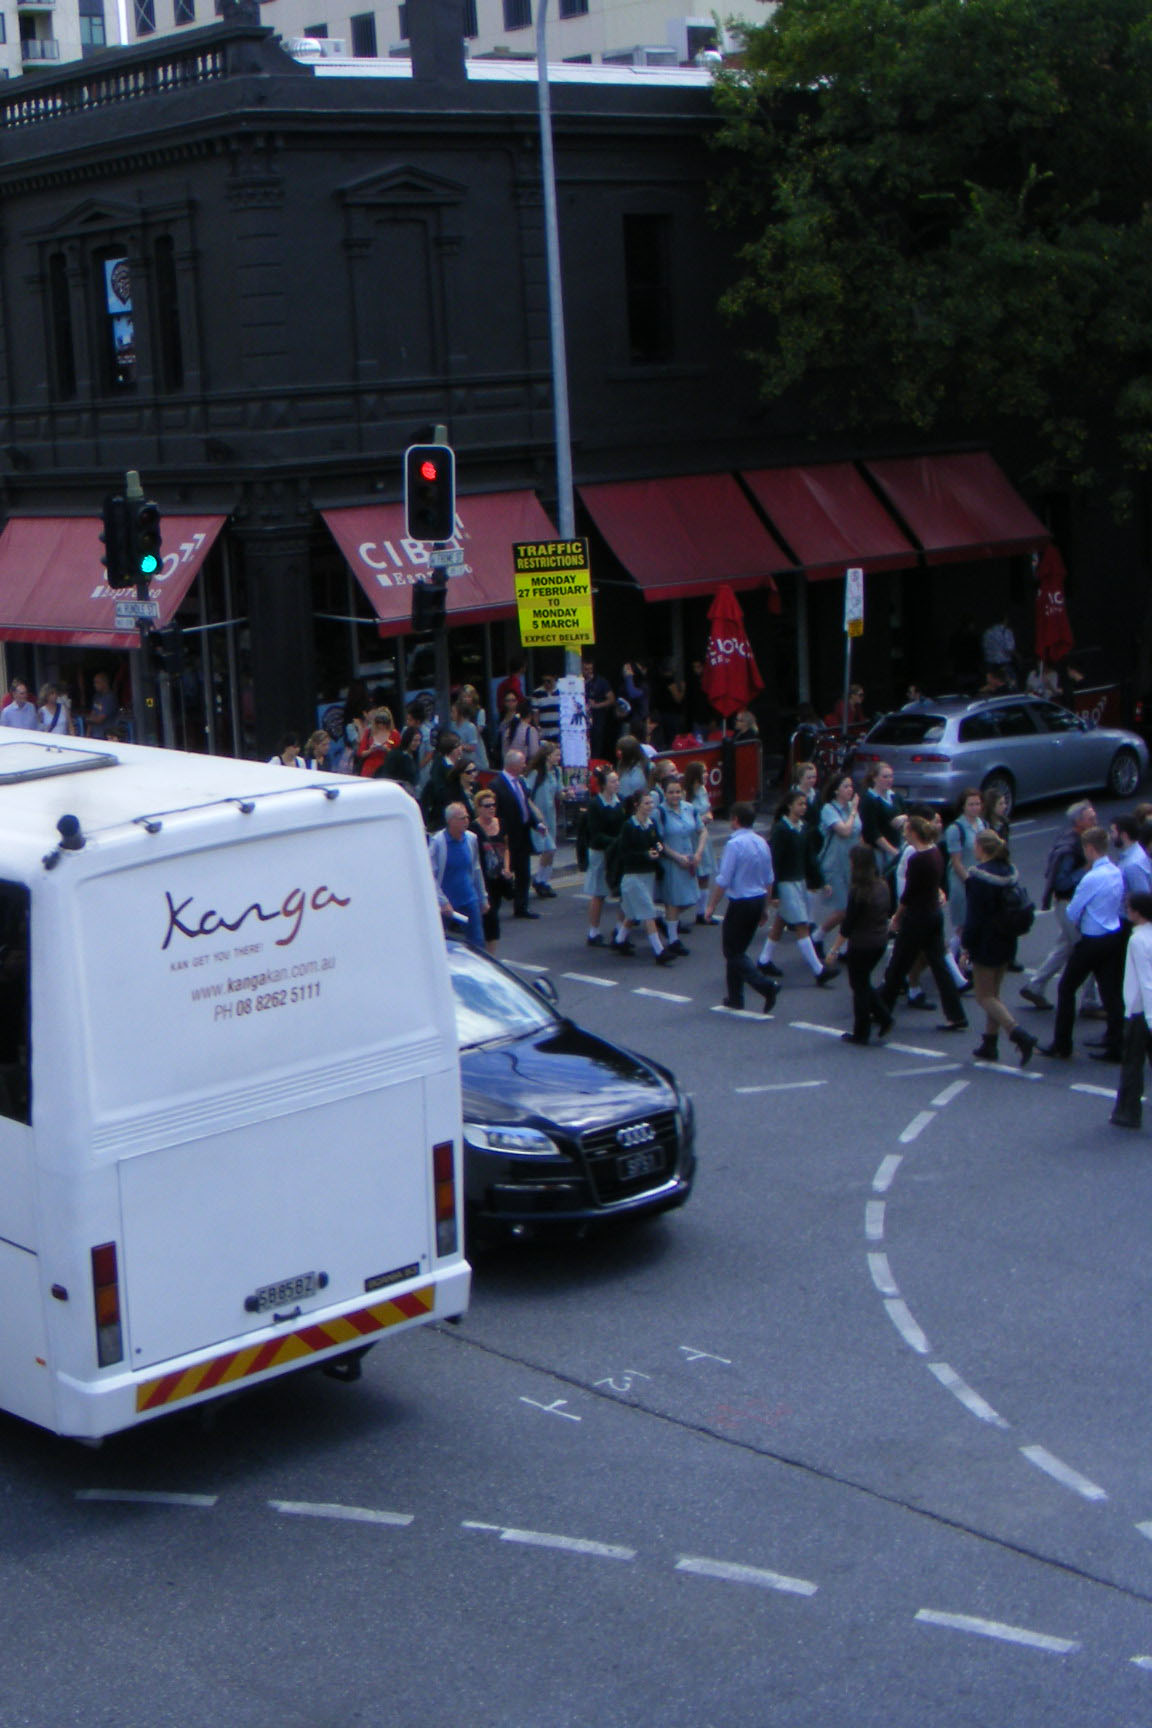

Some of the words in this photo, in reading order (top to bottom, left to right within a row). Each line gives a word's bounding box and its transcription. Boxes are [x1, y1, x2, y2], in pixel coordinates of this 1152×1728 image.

[358, 538, 460, 569] CIB
[518, 543, 583, 557] TRAFFIC
[517, 554, 585, 569] RESTRICTIONS
[531, 575, 577, 587] MONDAY
[518, 588, 530, 598] 27
[533, 585, 589, 597] FEBRUARY
[548, 598, 560, 607] TO
[533, 608, 578, 618] MONDAY
[532, 620, 539, 629] 5
[541, 619, 580, 629] MARCH
[525, 634, 557, 643] EXPECT
[559, 632, 591, 642] DELAYS
[161, 885, 351, 951] Kanga
[170, 960, 190, 973] KAN
[192, 954, 210, 968] GET
[213, 950, 231, 963] YOU
[191, 956, 337, 1002] www.kangakan.com.au
[214, 1002, 234, 1021] PH
[236, 998, 253, 1017] 08
[255, 989, 288, 1012] 8262
[290, 981, 321, 1003] 5111
